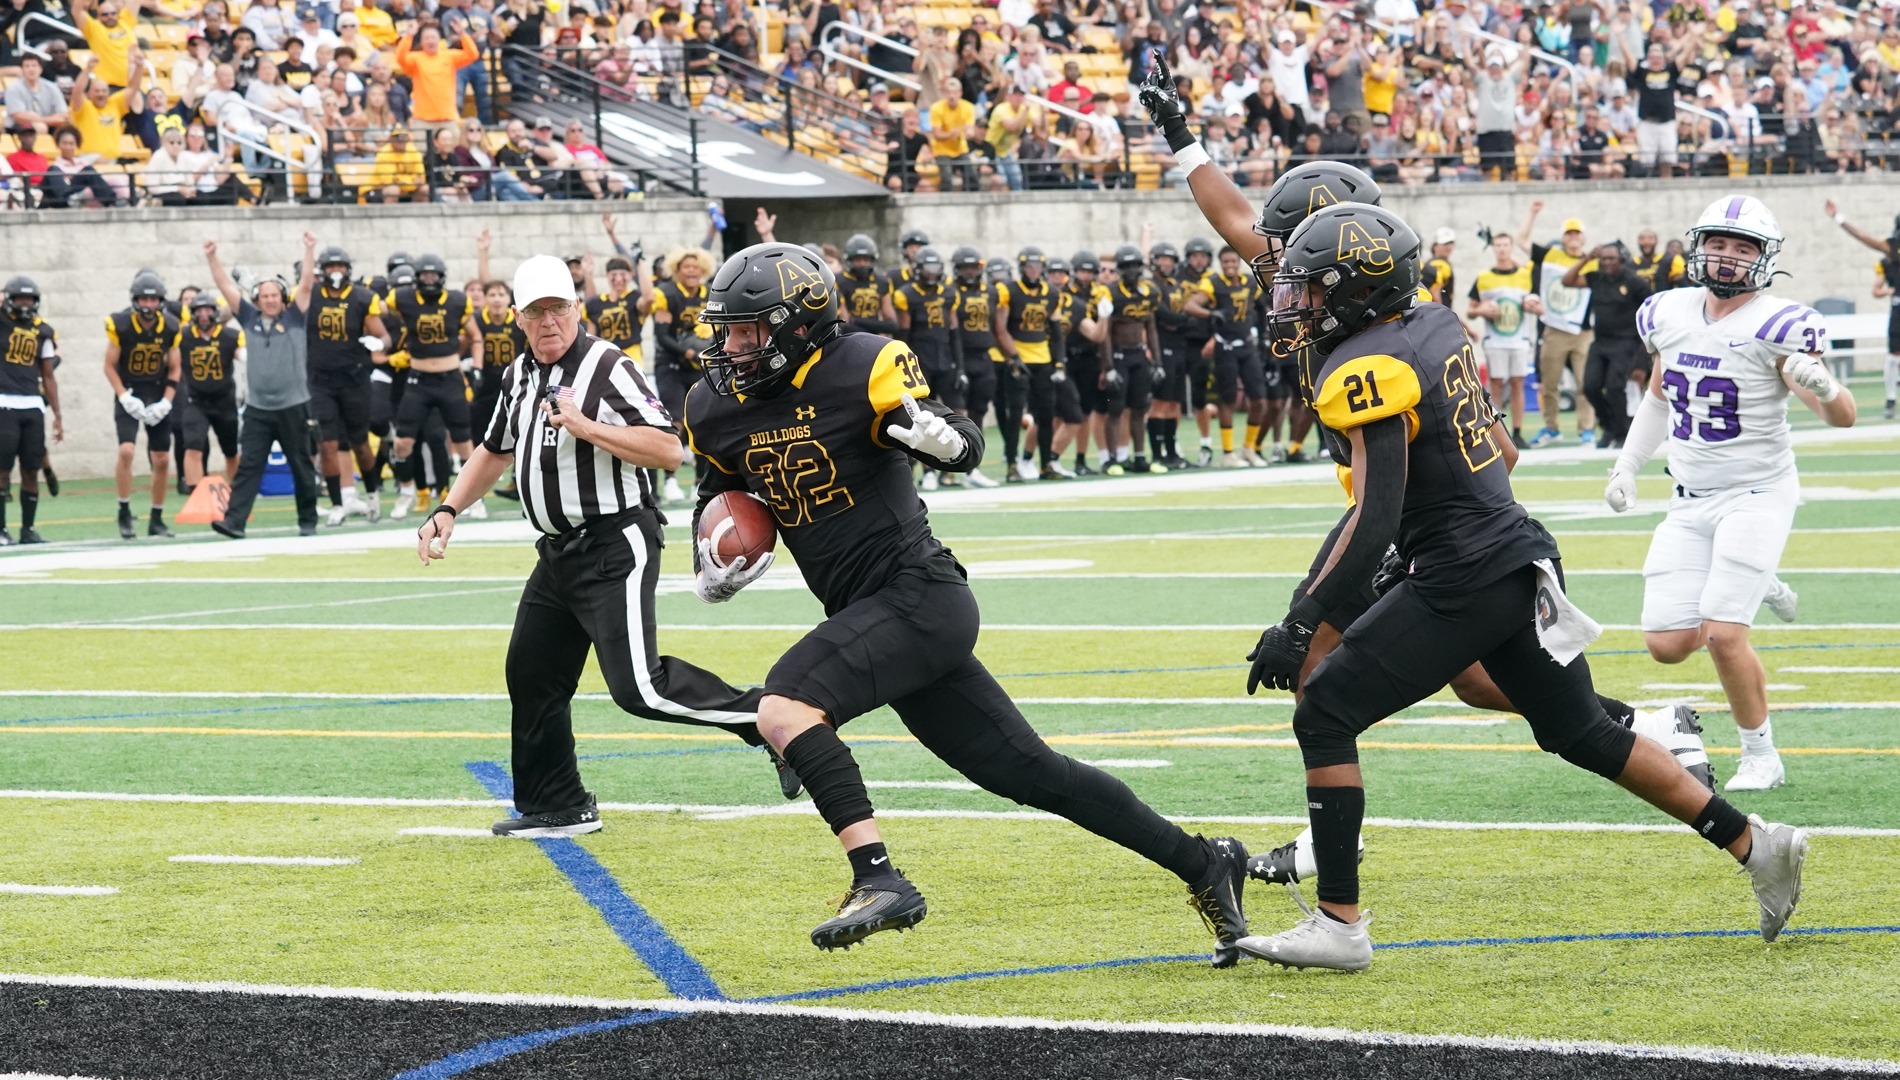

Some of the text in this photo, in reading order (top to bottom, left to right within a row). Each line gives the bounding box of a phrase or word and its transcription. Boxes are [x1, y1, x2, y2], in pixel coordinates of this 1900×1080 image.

[416, 318, 449, 344] 51
[5, 333, 38, 366] 10
[190, 348, 223, 381] 54
[1677, 352, 1722, 371] BLUFFTON
[895, 350, 927, 390] 32
[1343, 370, 1384, 413] 21
[1661, 368, 1742, 443] 33
[543, 426, 557, 447] R
[749, 425, 811, 447] BULLDOGS
[745, 440, 855, 527] 32
